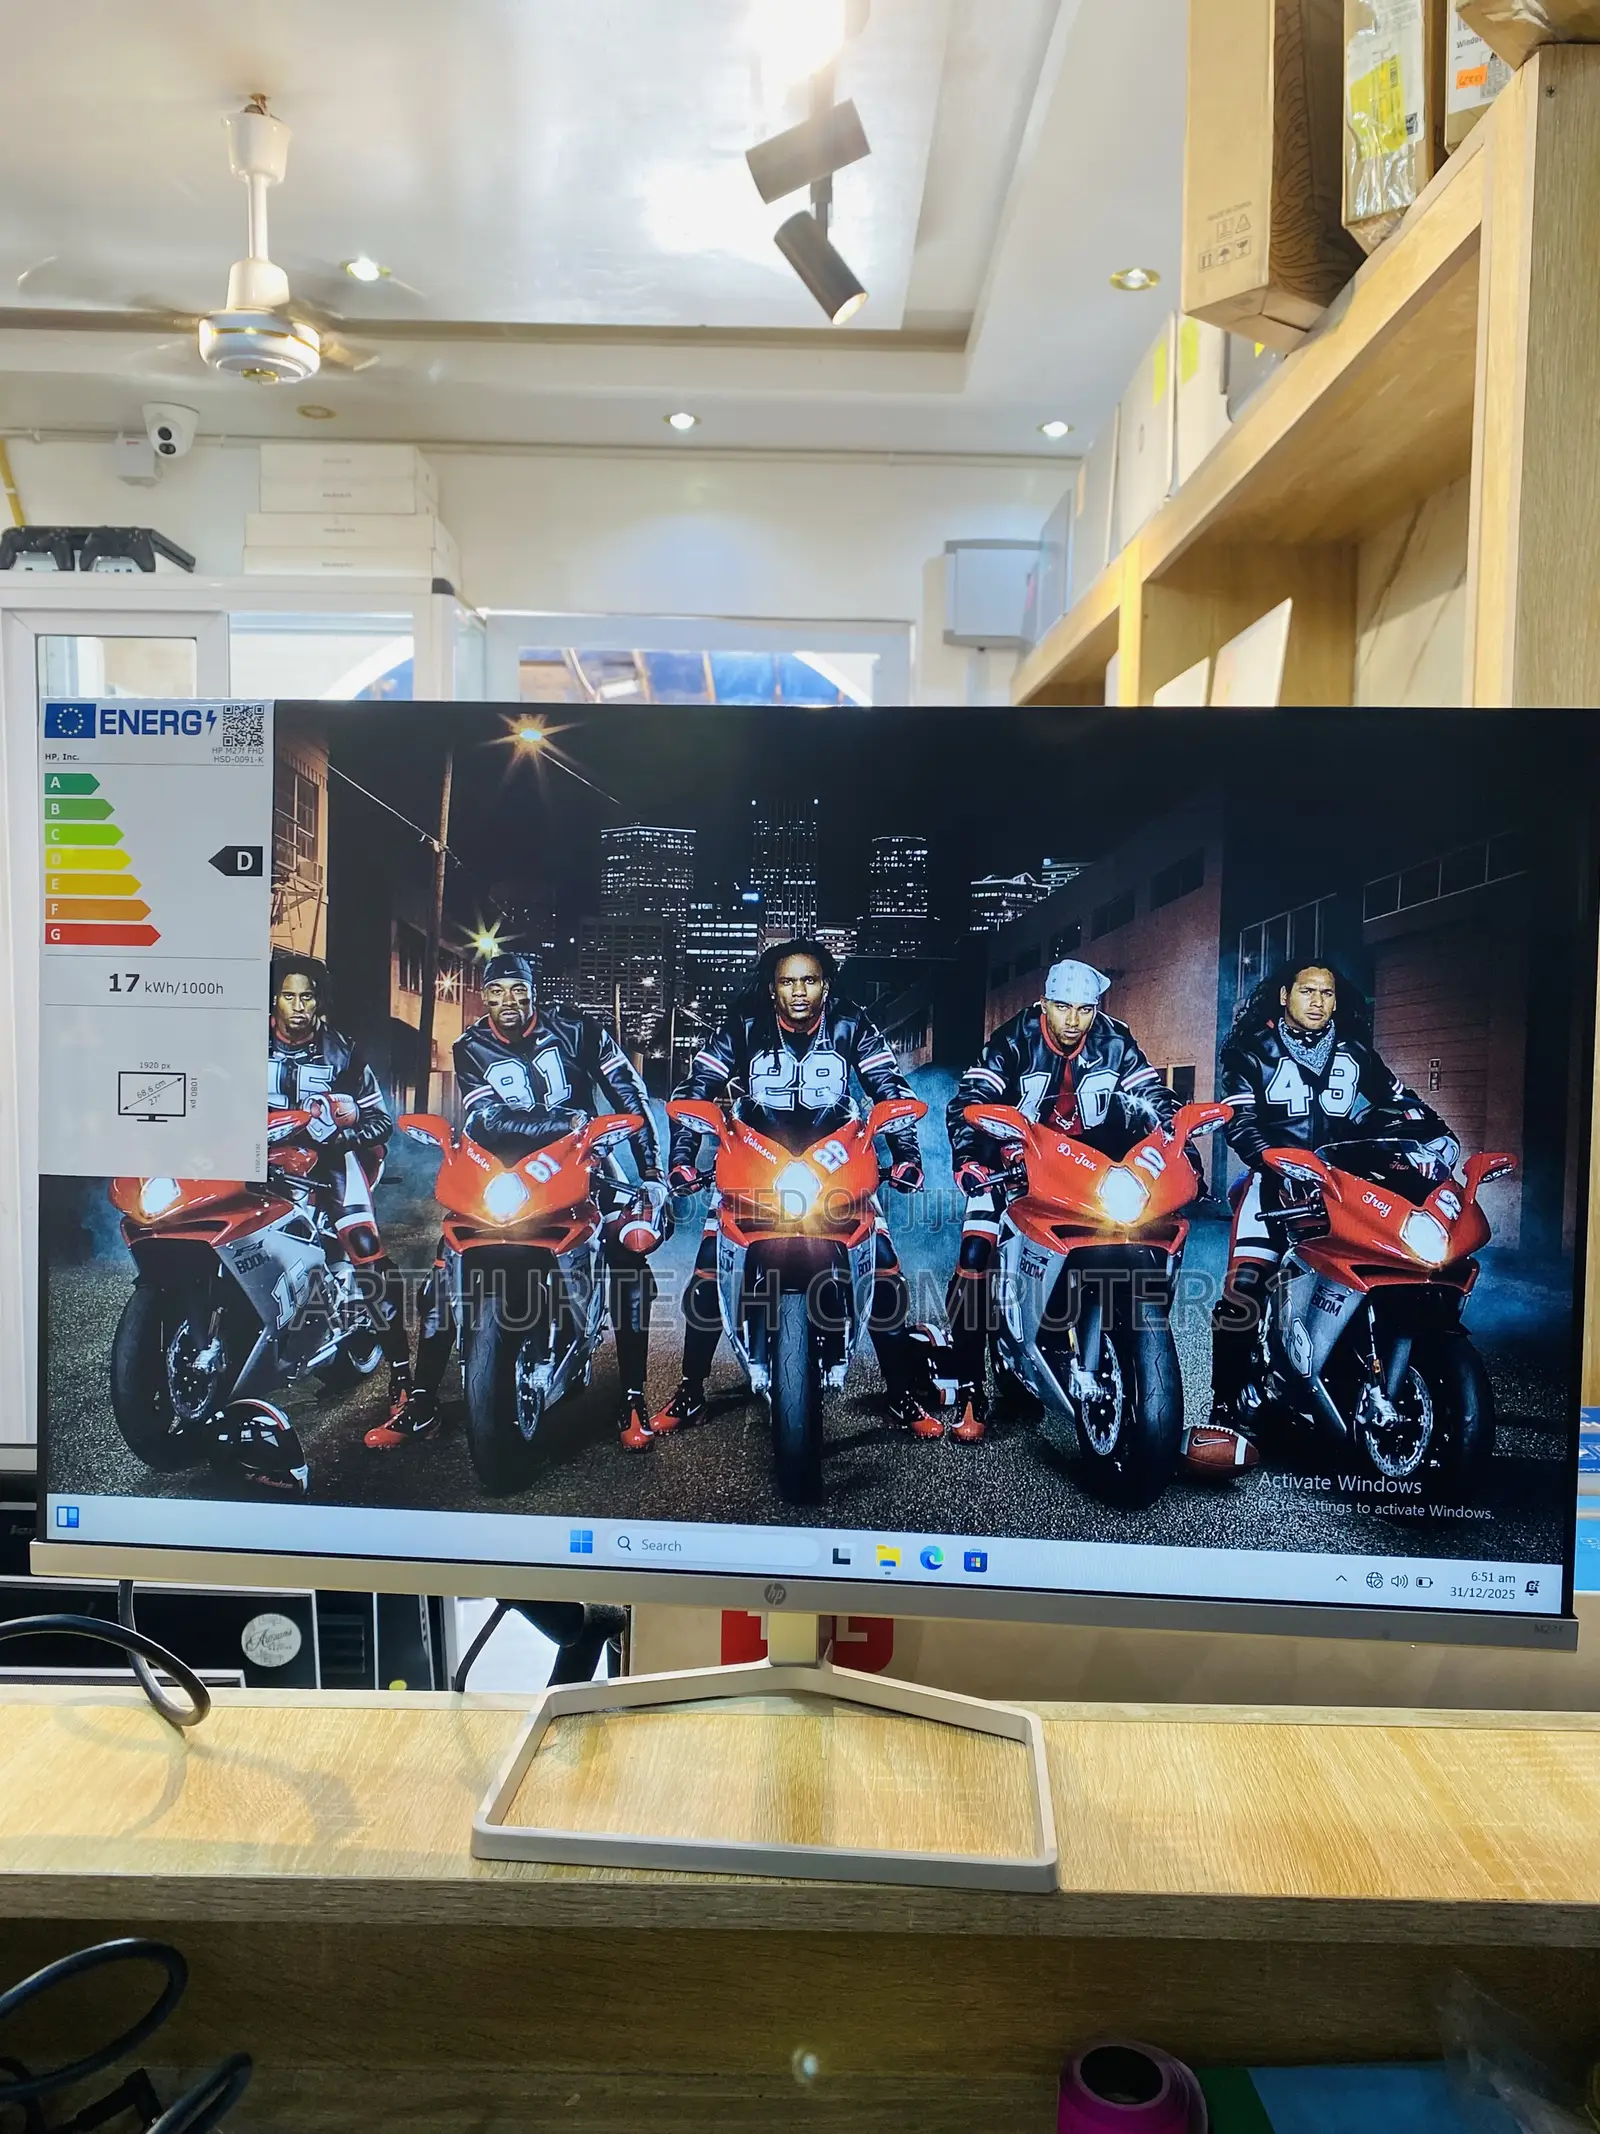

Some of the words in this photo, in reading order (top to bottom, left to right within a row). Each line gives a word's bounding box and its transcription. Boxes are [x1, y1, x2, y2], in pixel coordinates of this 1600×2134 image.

[45, 753, 60, 762] HP,
[62, 753, 80, 761] Inc.
[212, 747, 223, 755] HP
[247, 747, 265, 755] FHD
[213, 755, 264, 764] HSD-0091-K
[50, 776, 61, 789] A
[51, 803, 61, 815] B
[51, 828, 60, 841] C
[236, 852, 254, 871] D
[52, 878, 60, 891] E
[51, 904, 59, 916] F
[51, 928, 61, 941] G
[109, 973, 141, 993] 17
[144, 981, 224, 996] kWh/1000h
[139, 1061, 160, 1070] 1920
[153, 1079, 167, 1092] cm
[190, 1077, 198, 1097] 1080
[483, 1046, 572, 1112] 81
[748, 1049, 848, 1111] 28
[1266, 1051, 1360, 1119] 43
[743, 1131, 778, 1165] Johnson
[467, 1147, 492, 1172] Calvin
[812, 1139, 850, 1174] 28
[1056, 1142, 1098, 1172] D-Jax
[1361, 1191, 1393, 1218] Troy
[1258, 1471, 1332, 1490] Activate
[1337, 1474, 1422, 1494] Windows
[1300, 1500, 1352, 1516] Settings
[1356, 1503, 1371, 1514] to
[1374, 1504, 1425, 1517] activate
[1429, 1504, 1496, 1520] Windows.
[641, 1538, 683, 1554] Search
[1471, 1571, 1494, 1583] 6:51
[1498, 1573, 1516, 1583] am
[1450, 1586, 1516, 1600] 31/12/2025
